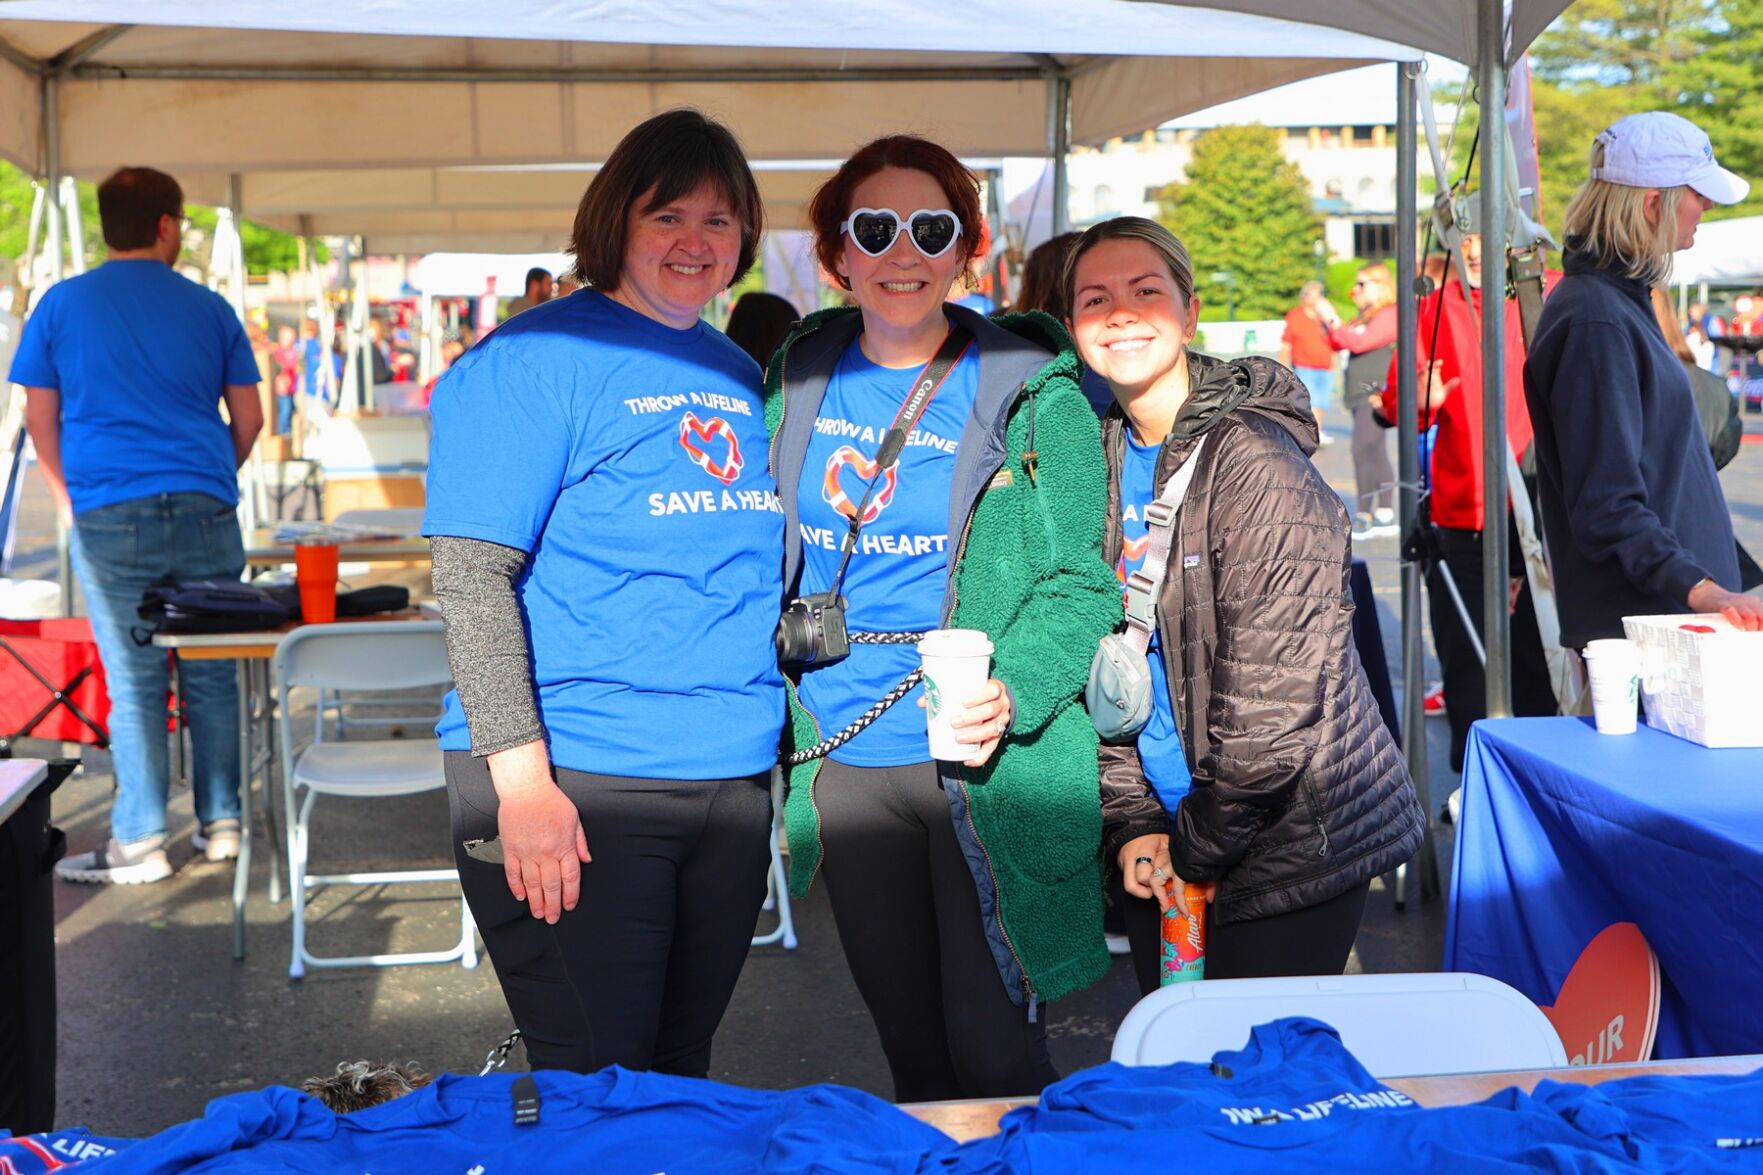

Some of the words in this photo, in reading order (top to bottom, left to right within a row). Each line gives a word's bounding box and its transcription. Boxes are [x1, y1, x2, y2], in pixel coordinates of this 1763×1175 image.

[624, 394, 689, 415] THROW
[689, 391, 703, 406] A
[701, 391, 752, 416] LIFELINE
[904, 379, 933, 420] Canon
[814, 416, 861, 438] HROW
[860, 426, 875, 443] A
[648, 490, 717, 516] SAVE
[721, 489, 738, 511] A
[800, 523, 836, 551] AVE
[862, 534, 948, 556] HEART
